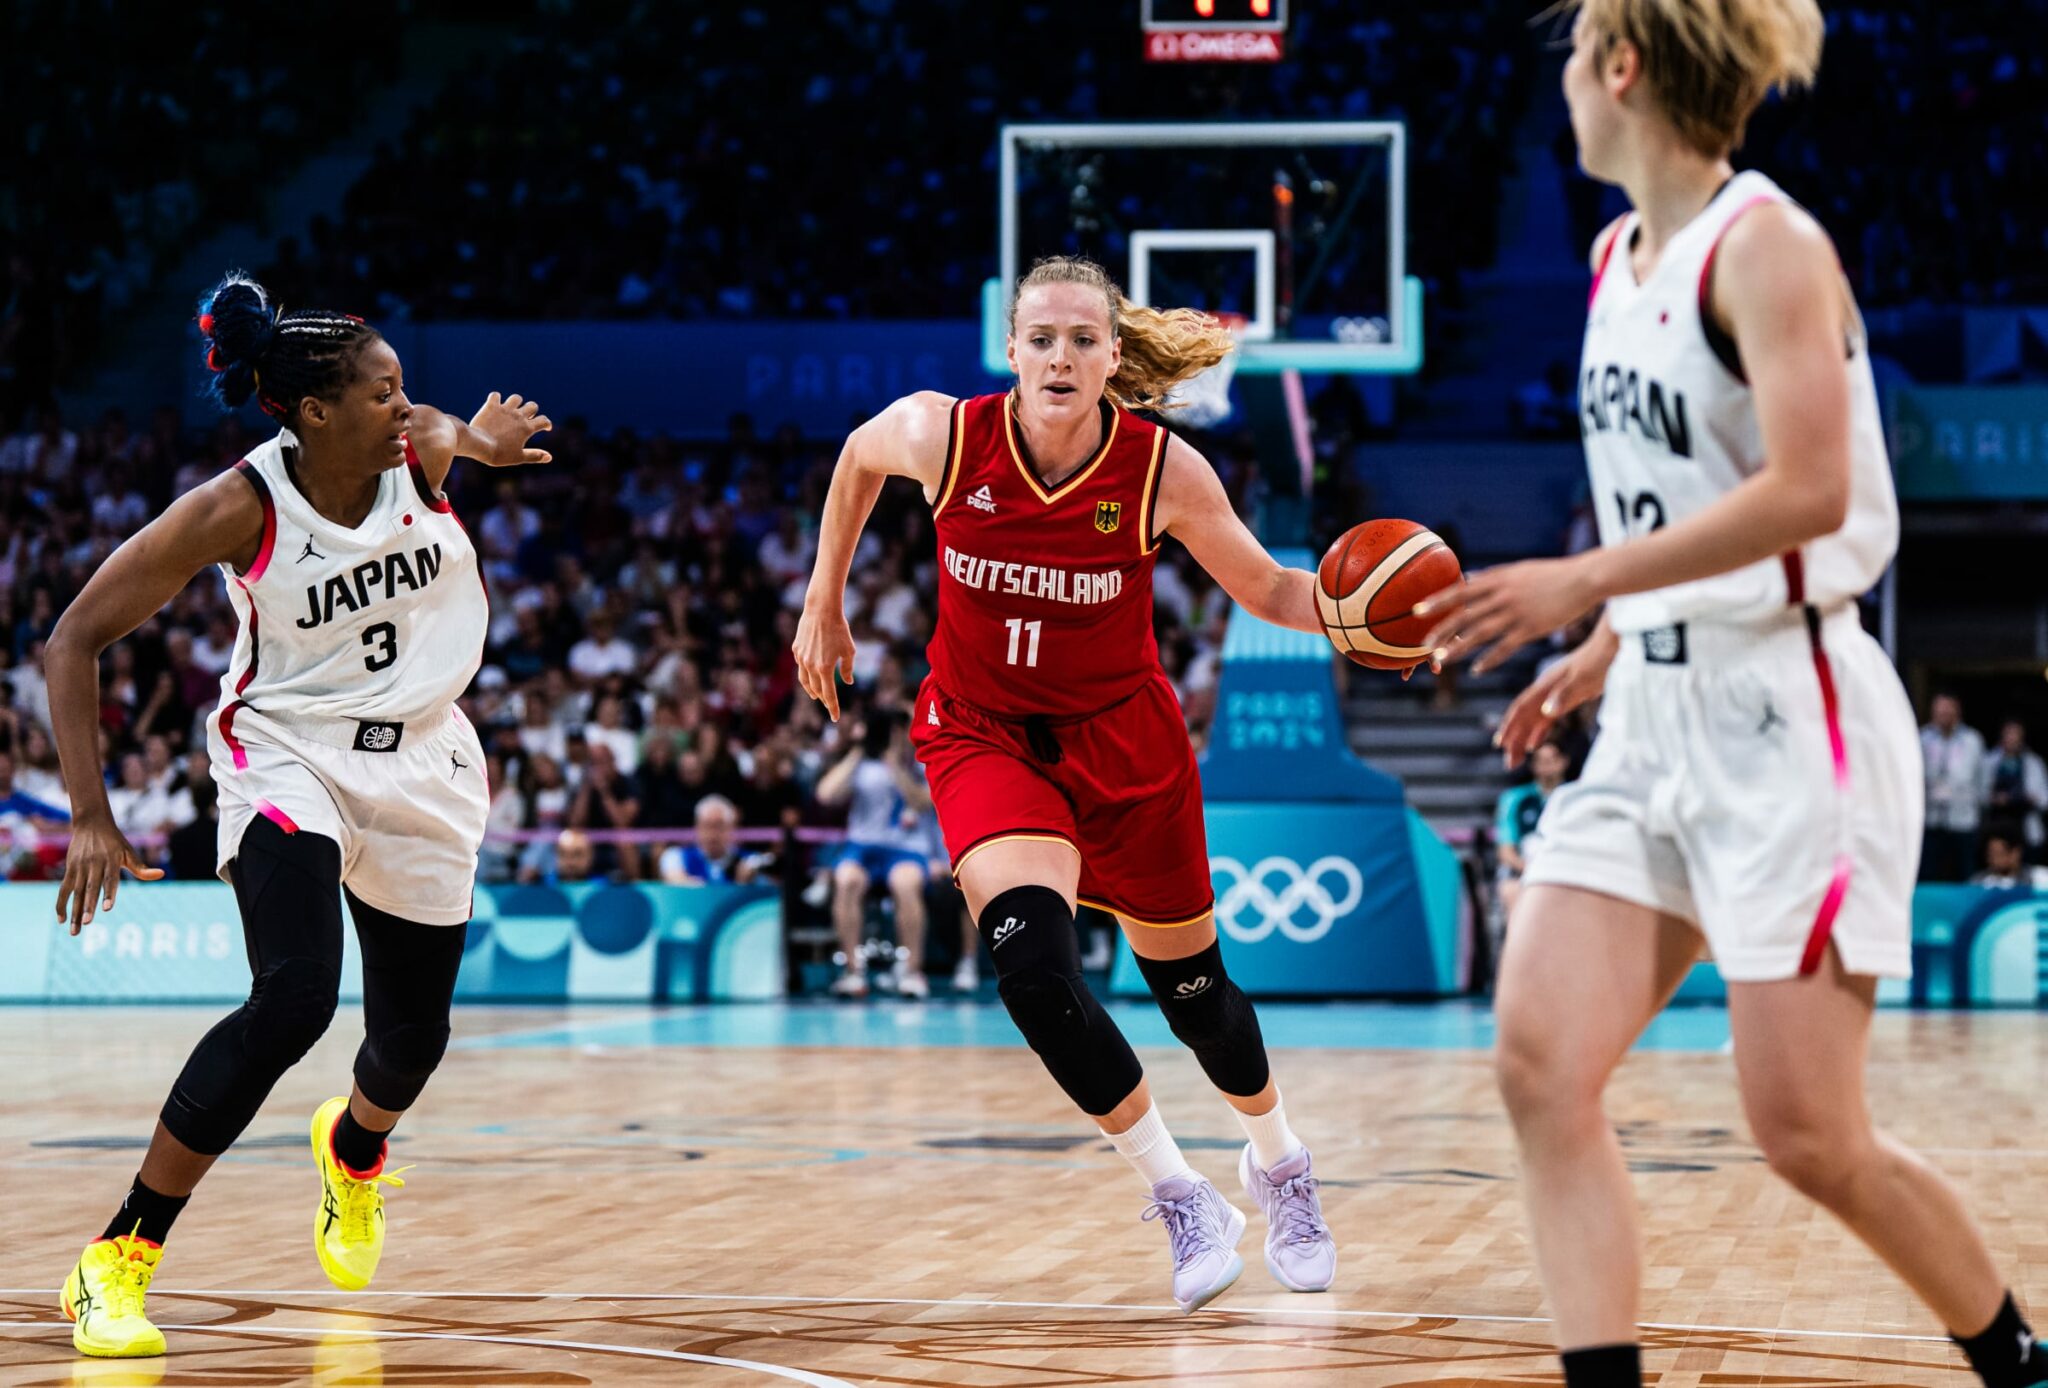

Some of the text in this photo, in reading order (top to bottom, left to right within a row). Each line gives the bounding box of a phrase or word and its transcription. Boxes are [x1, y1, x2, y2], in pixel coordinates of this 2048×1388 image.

[1181, 33, 1280, 60] OMEGA
[1581, 365, 1692, 458] APAN
[967, 494, 997, 514] PEAK
[296, 543, 441, 629] JAPAN
[944, 545, 1122, 604] DEUTSCHLAND
[361, 621, 397, 672] 3
[1005, 618, 1042, 668] 11
[82, 922, 231, 959] PARIS
